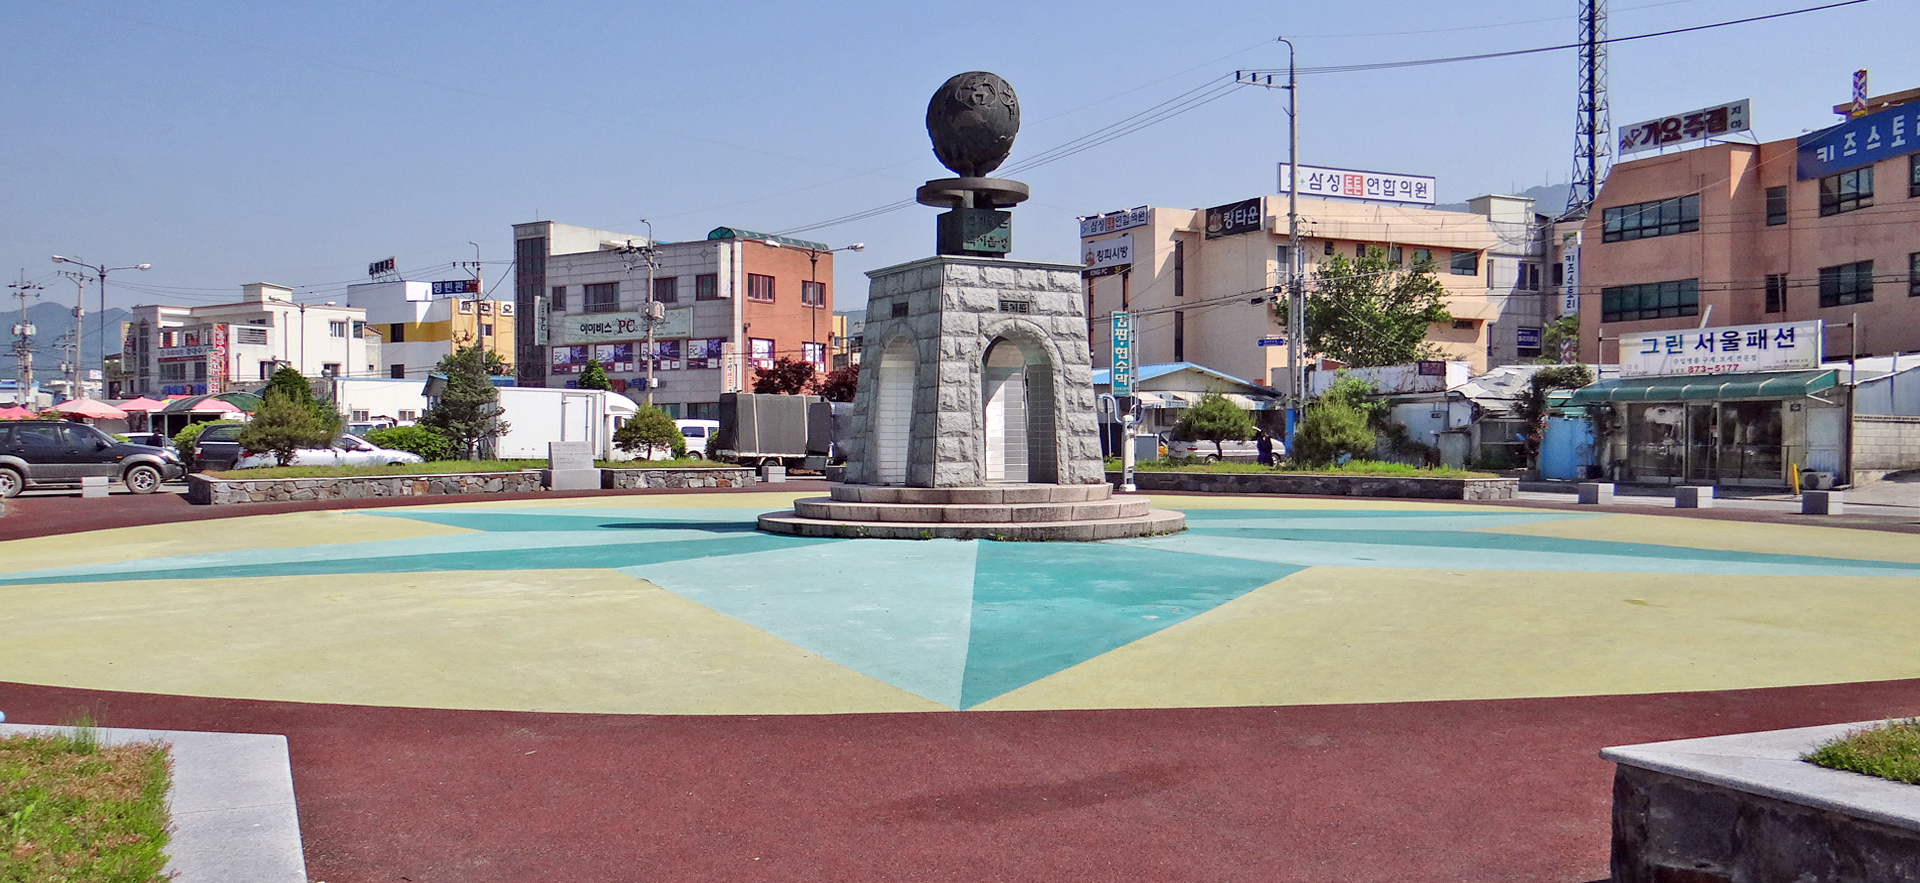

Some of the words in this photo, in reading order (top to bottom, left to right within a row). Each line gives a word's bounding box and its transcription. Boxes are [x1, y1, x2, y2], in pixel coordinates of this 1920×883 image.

[1641, 107, 1728, 145] 가요주점
[1730, 105, 1742, 128] 지하
[1096, 245, 1128, 262] 킹피시방
[433, 281, 465, 293] 영빈관
[1565, 254, 1575, 309] 키즈스토리
[617, 319, 636, 334] PC
[1640, 333, 1684, 355] 그린
[1694, 327, 1795, 353] 서울패션
[1687, 363, 1739, 374] 873-5177
